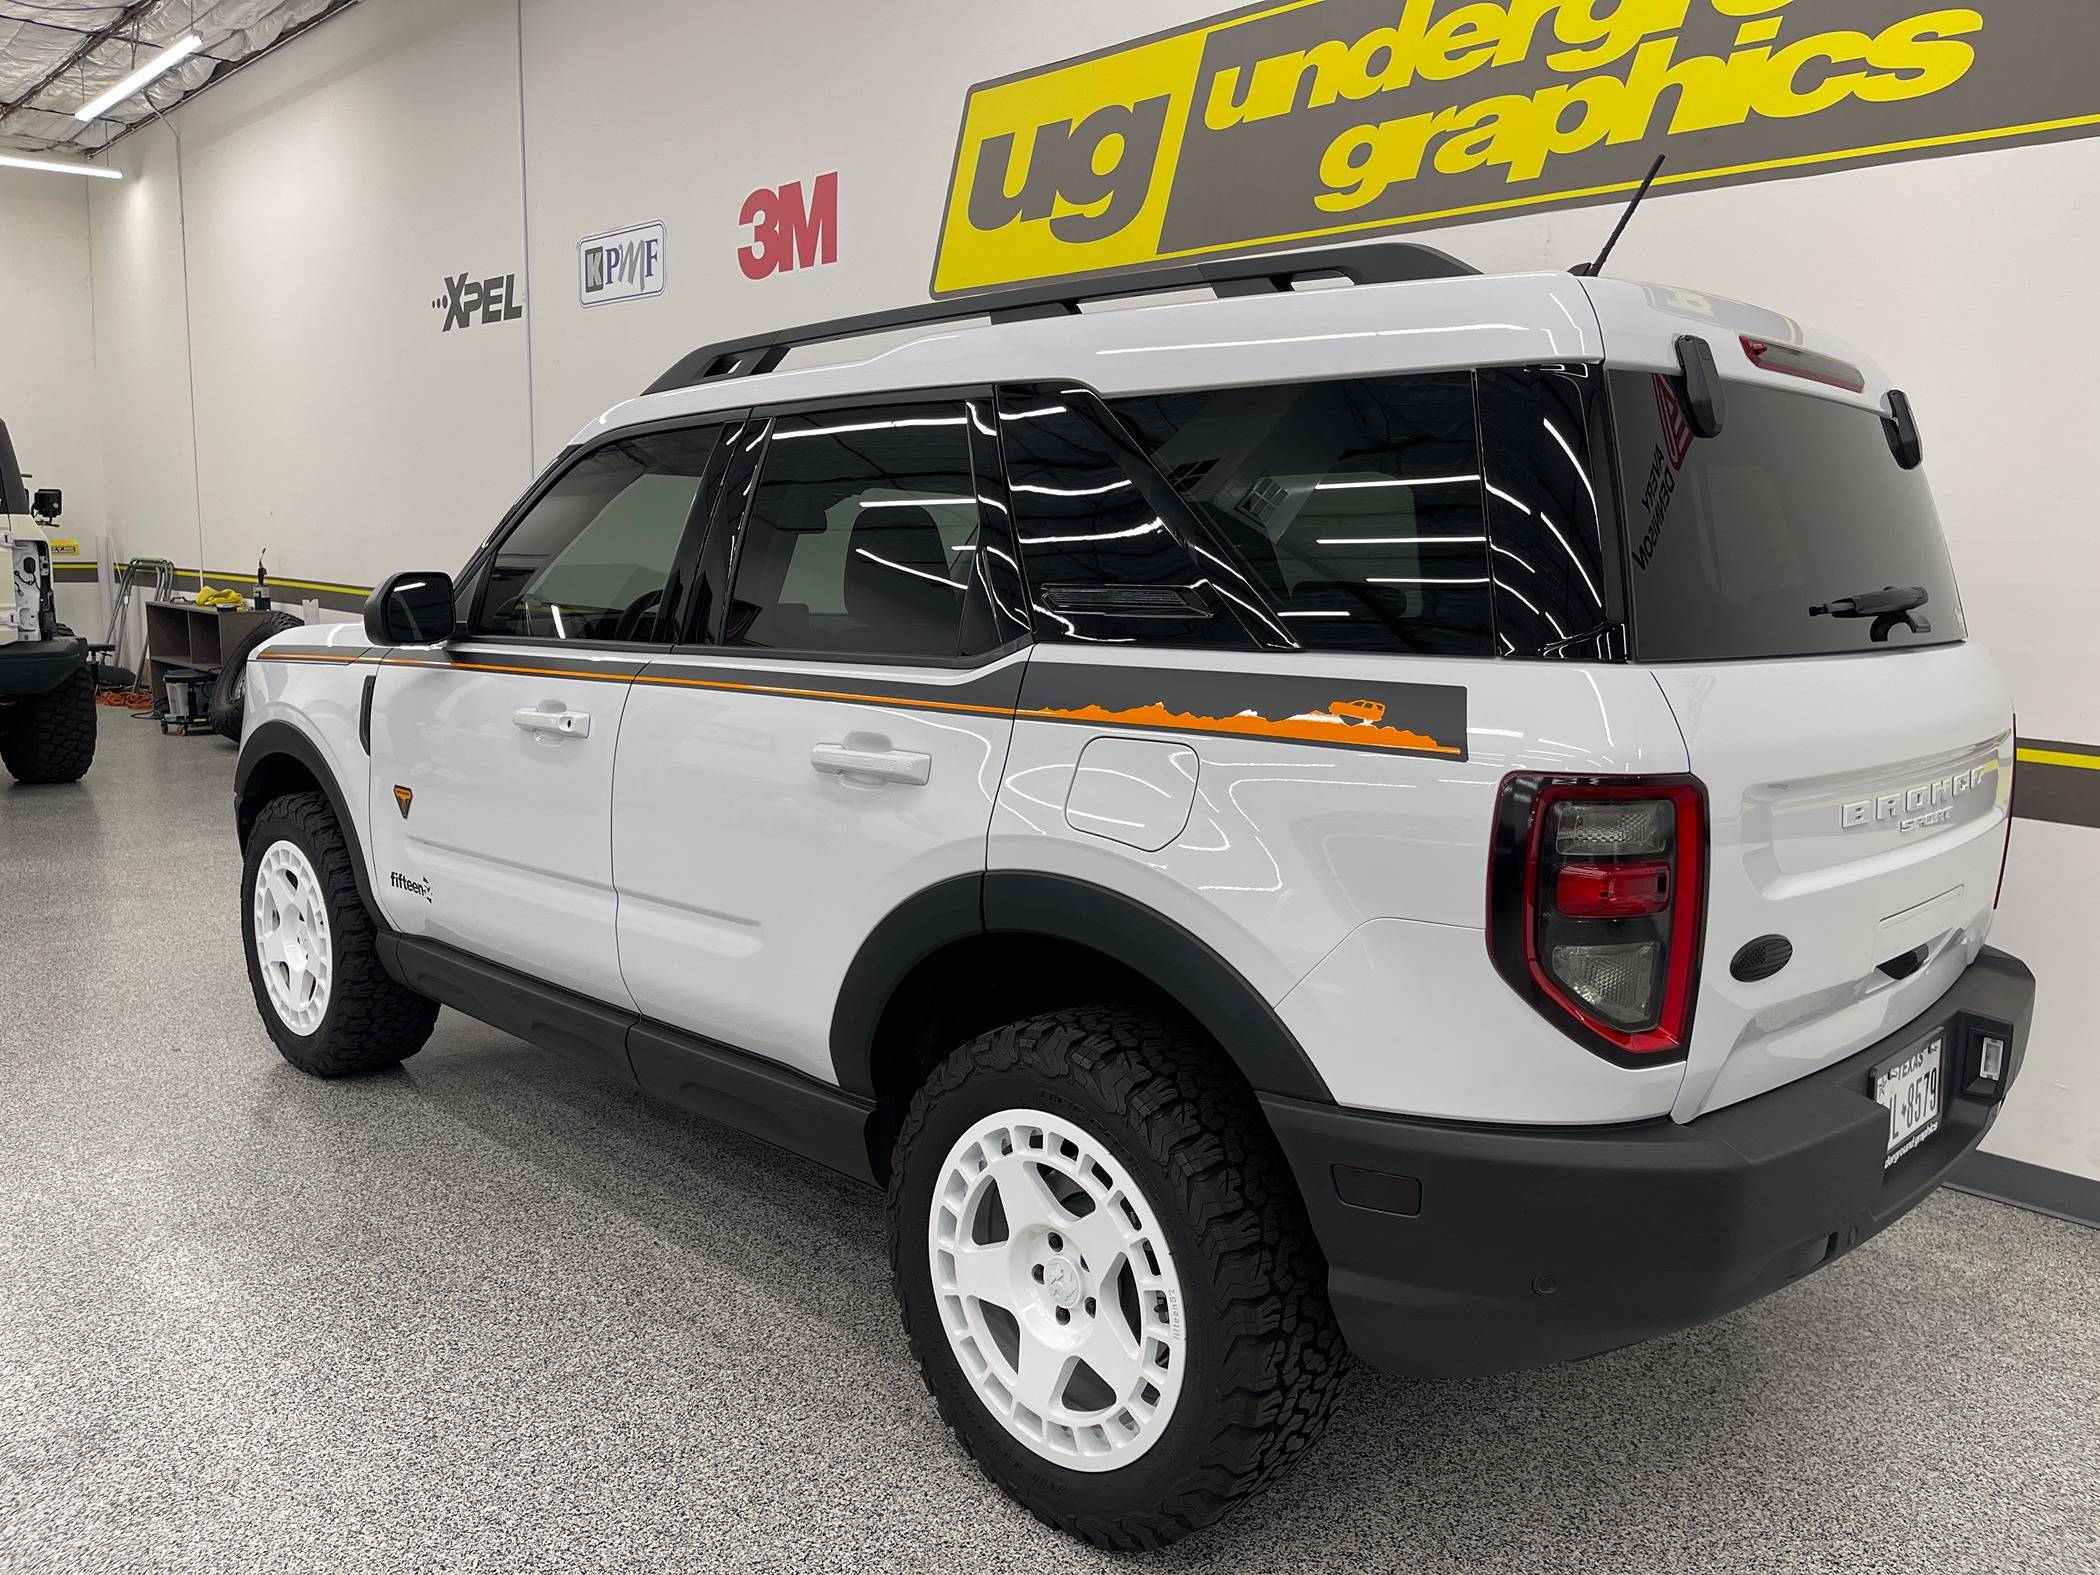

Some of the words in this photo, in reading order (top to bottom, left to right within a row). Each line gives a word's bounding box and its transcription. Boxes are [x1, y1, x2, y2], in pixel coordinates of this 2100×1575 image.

[1313, 8, 1984, 213] graphics
[967, 92, 1173, 245] ug
[584, 238, 660, 293] KPMF
[736, 170, 840, 281] 3M
[440, 272, 523, 332] XPEL
[1842, 765, 1984, 828] BRONCO
